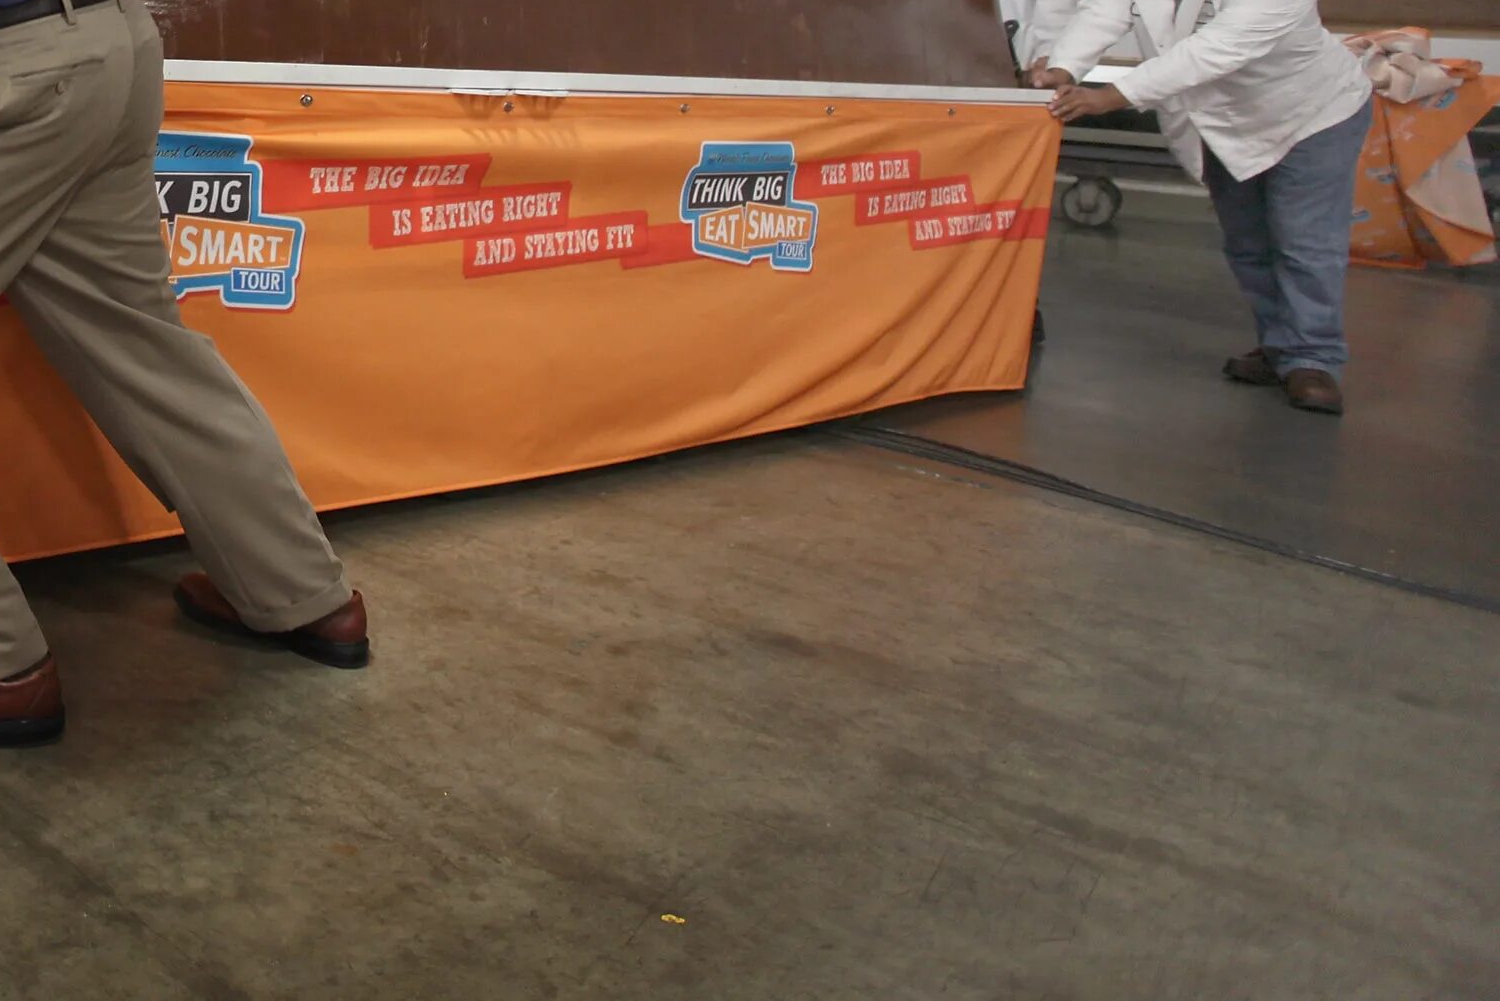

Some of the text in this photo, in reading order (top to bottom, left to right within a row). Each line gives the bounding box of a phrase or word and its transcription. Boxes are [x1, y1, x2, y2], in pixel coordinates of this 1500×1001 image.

[309, 163, 470, 194] THE BIG IDEA
[821, 159, 911, 186] THE BIG IDEA
[187, 180, 242, 214] BIG
[691, 175, 785, 203] THINK BIG
[868, 184, 968, 217] IS EATING RIGHT
[392, 192, 561, 236] IS EATING RIGHT
[705, 210, 808, 245] EAT SMART
[915, 219, 944, 241] AND
[949, 213, 992, 237] STAYING
[177, 226, 284, 266] SMART
[474, 224, 635, 266] AND STAYING FIT
[781, 243, 805, 257] TOUR
[239, 270, 281, 291] TOUR
